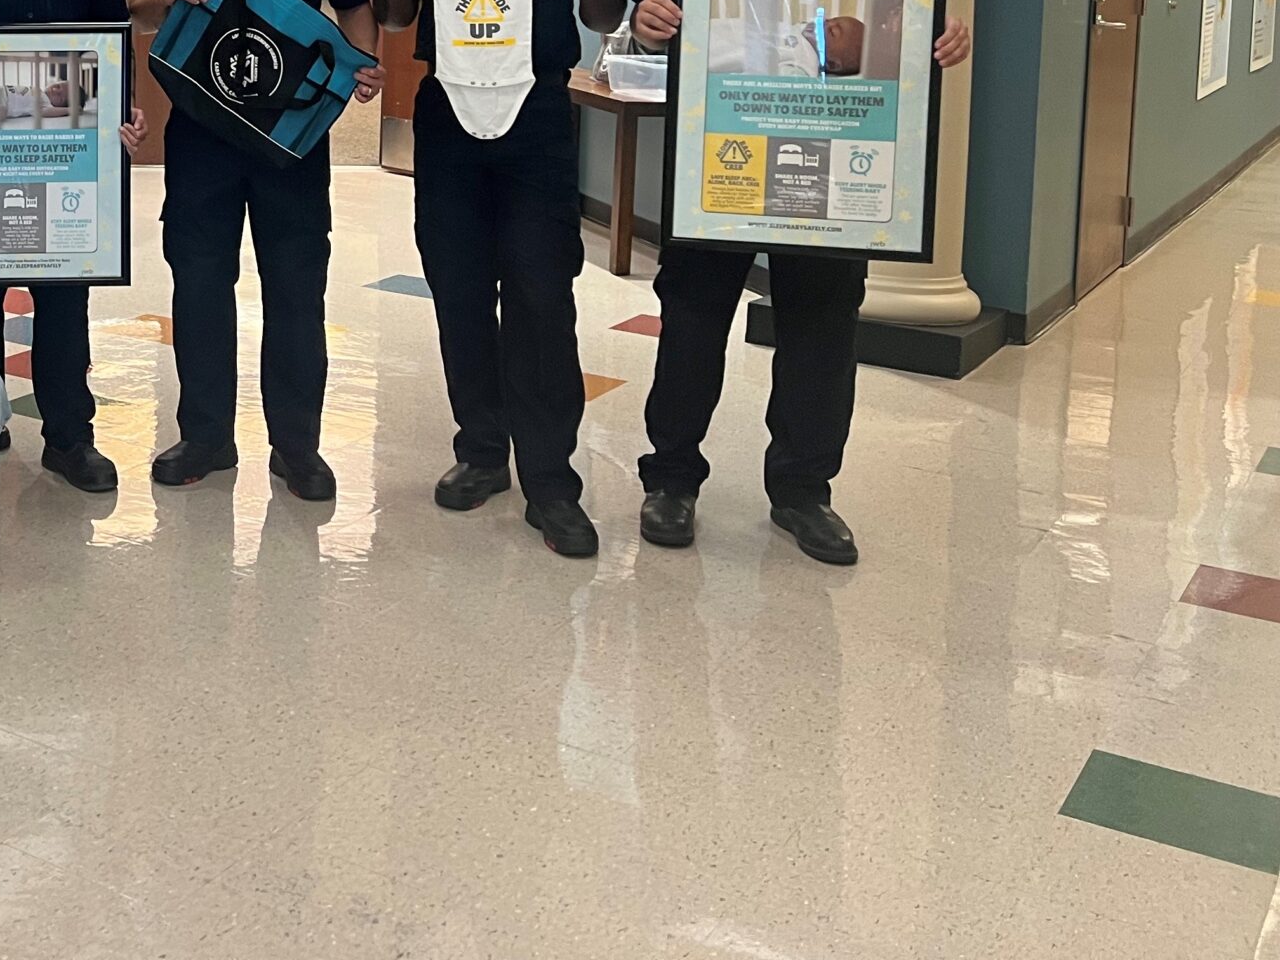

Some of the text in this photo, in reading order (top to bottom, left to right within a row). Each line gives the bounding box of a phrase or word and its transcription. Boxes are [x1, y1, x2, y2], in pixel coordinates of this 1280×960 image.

[470, 23, 500, 39] UP
[719, 91, 884, 107] ONLY ONE WAY TO LAY THEM
[733, 103, 869, 118] DOWN TO SLEEP SAFELY
[2, 145, 25, 153] WAY
[26, 145, 39, 153] TO
[41, 144, 59, 152] LAY
[60, 144, 87, 152] THEM
[14, 155, 40, 163] SLEEP
[42, 154, 75, 163] SAFELY
